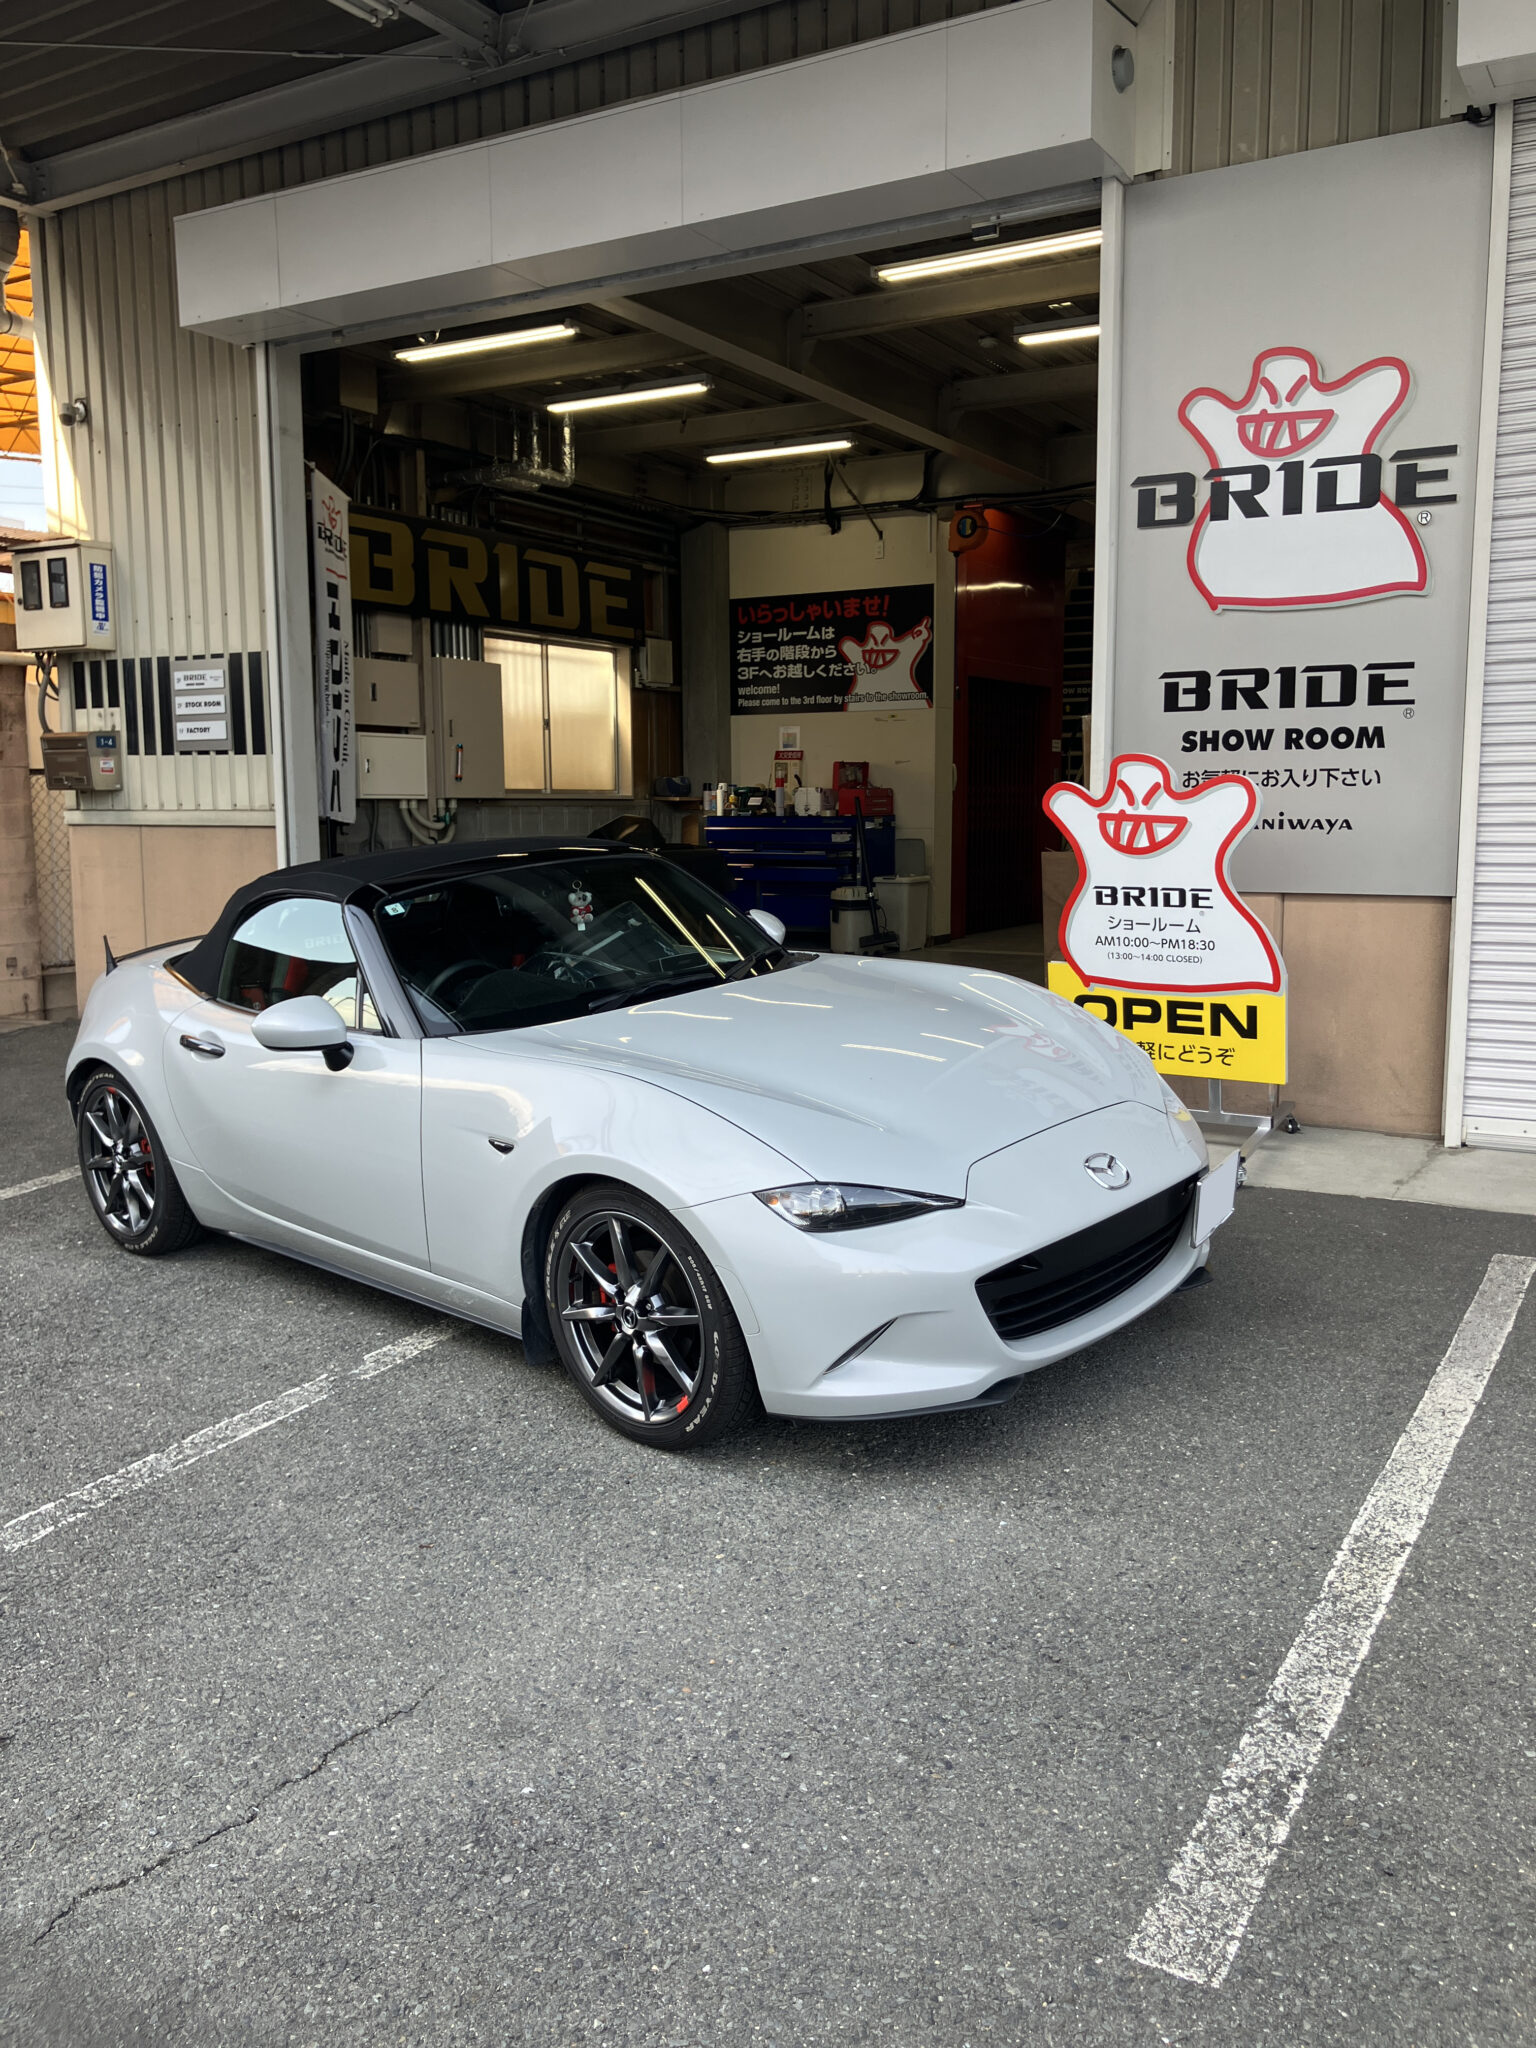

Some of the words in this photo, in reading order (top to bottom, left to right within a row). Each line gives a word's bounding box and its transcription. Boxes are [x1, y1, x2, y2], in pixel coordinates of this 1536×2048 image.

[1130, 444, 1457, 529] BRIDE
[348, 513, 634, 639] BRIDE
[737, 626, 835, 644] ショールームは
[736, 645, 837, 663] 右手の階段から
[737, 662, 878, 680] 3Fへお越しください。
[737, 683, 780, 695] welcome!
[1158, 661, 1415, 712] BRIDE
[738, 697, 760, 707] Please
[761, 698, 781, 706] come
[781, 697, 789, 705] to
[790, 696, 802, 704] the
[802, 696, 815, 704] 3rd
[816, 695, 833, 704] floor
[834, 694, 843, 705] by
[844, 693, 865, 703] stairs
[865, 692, 874, 702] to
[874, 692, 888, 701] the
[1181, 728, 1275, 752] SHOW
[1284, 726, 1386, 750] ROOM
[1182, 768, 1382, 788] お気お入り下さい
[1093, 885, 1213, 909] BRIDE
[1107, 915, 1201, 933] ショールーム
[1165, 954, 1203, 964] CLOSED)
[1074, 994, 1258, 1039] OPEN
